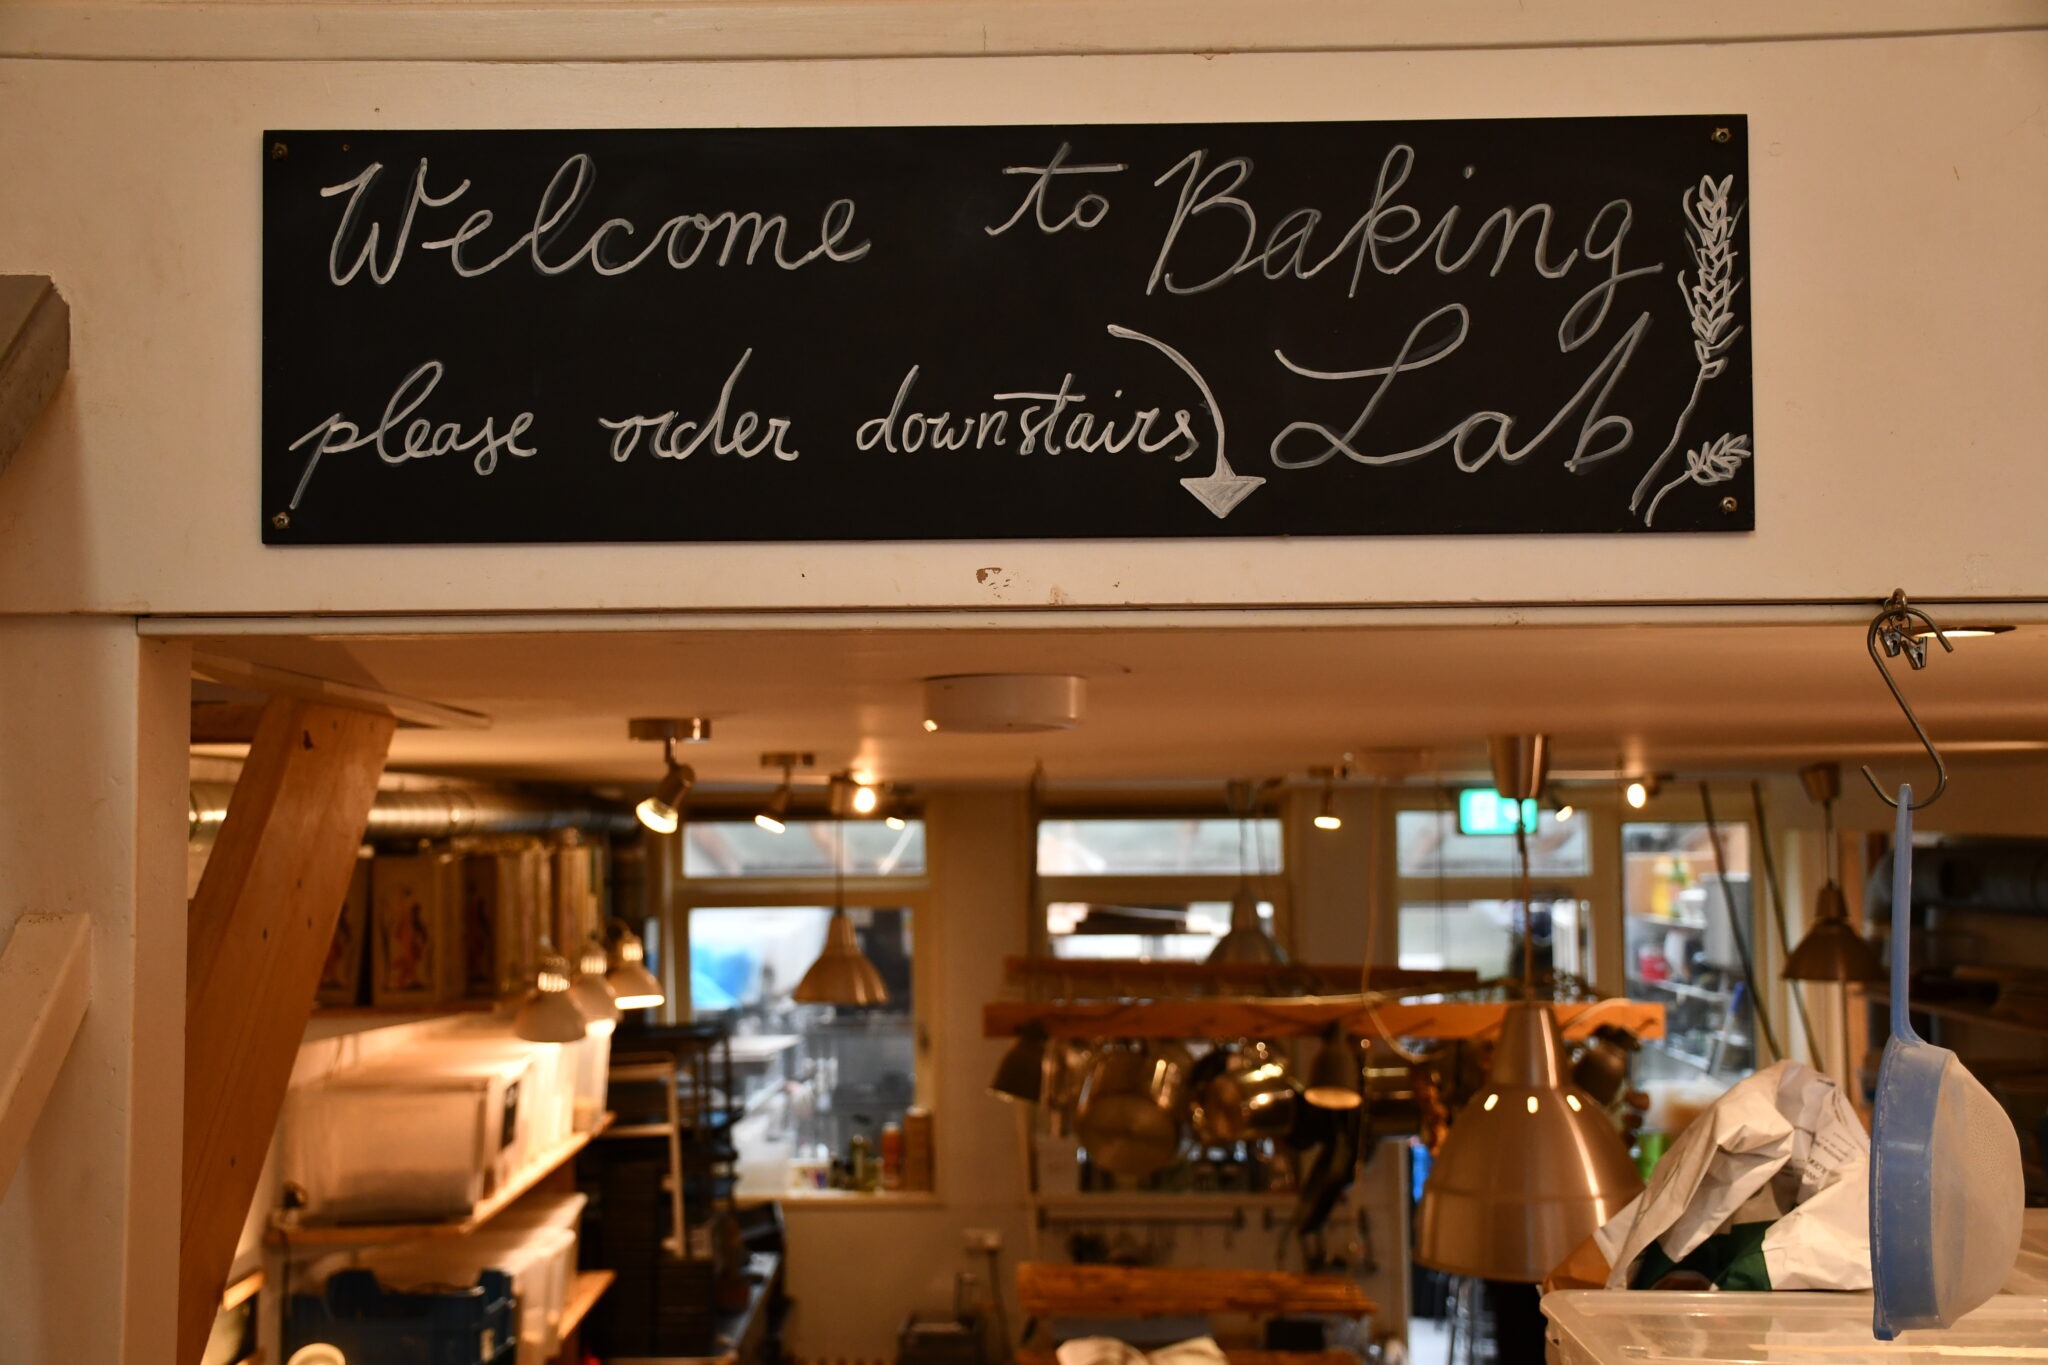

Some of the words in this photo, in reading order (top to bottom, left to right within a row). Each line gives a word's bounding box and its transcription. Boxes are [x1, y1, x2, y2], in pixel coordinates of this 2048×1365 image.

[320, 152, 871, 286] Welcome
[984, 142, 1127, 238] to
[1146, 144, 1664, 354] Baking
[287, 359, 538, 511] please
[598, 347, 800, 463] order
[855, 364, 1200, 464] downstairs
[1269, 302, 1651, 474] Lab
